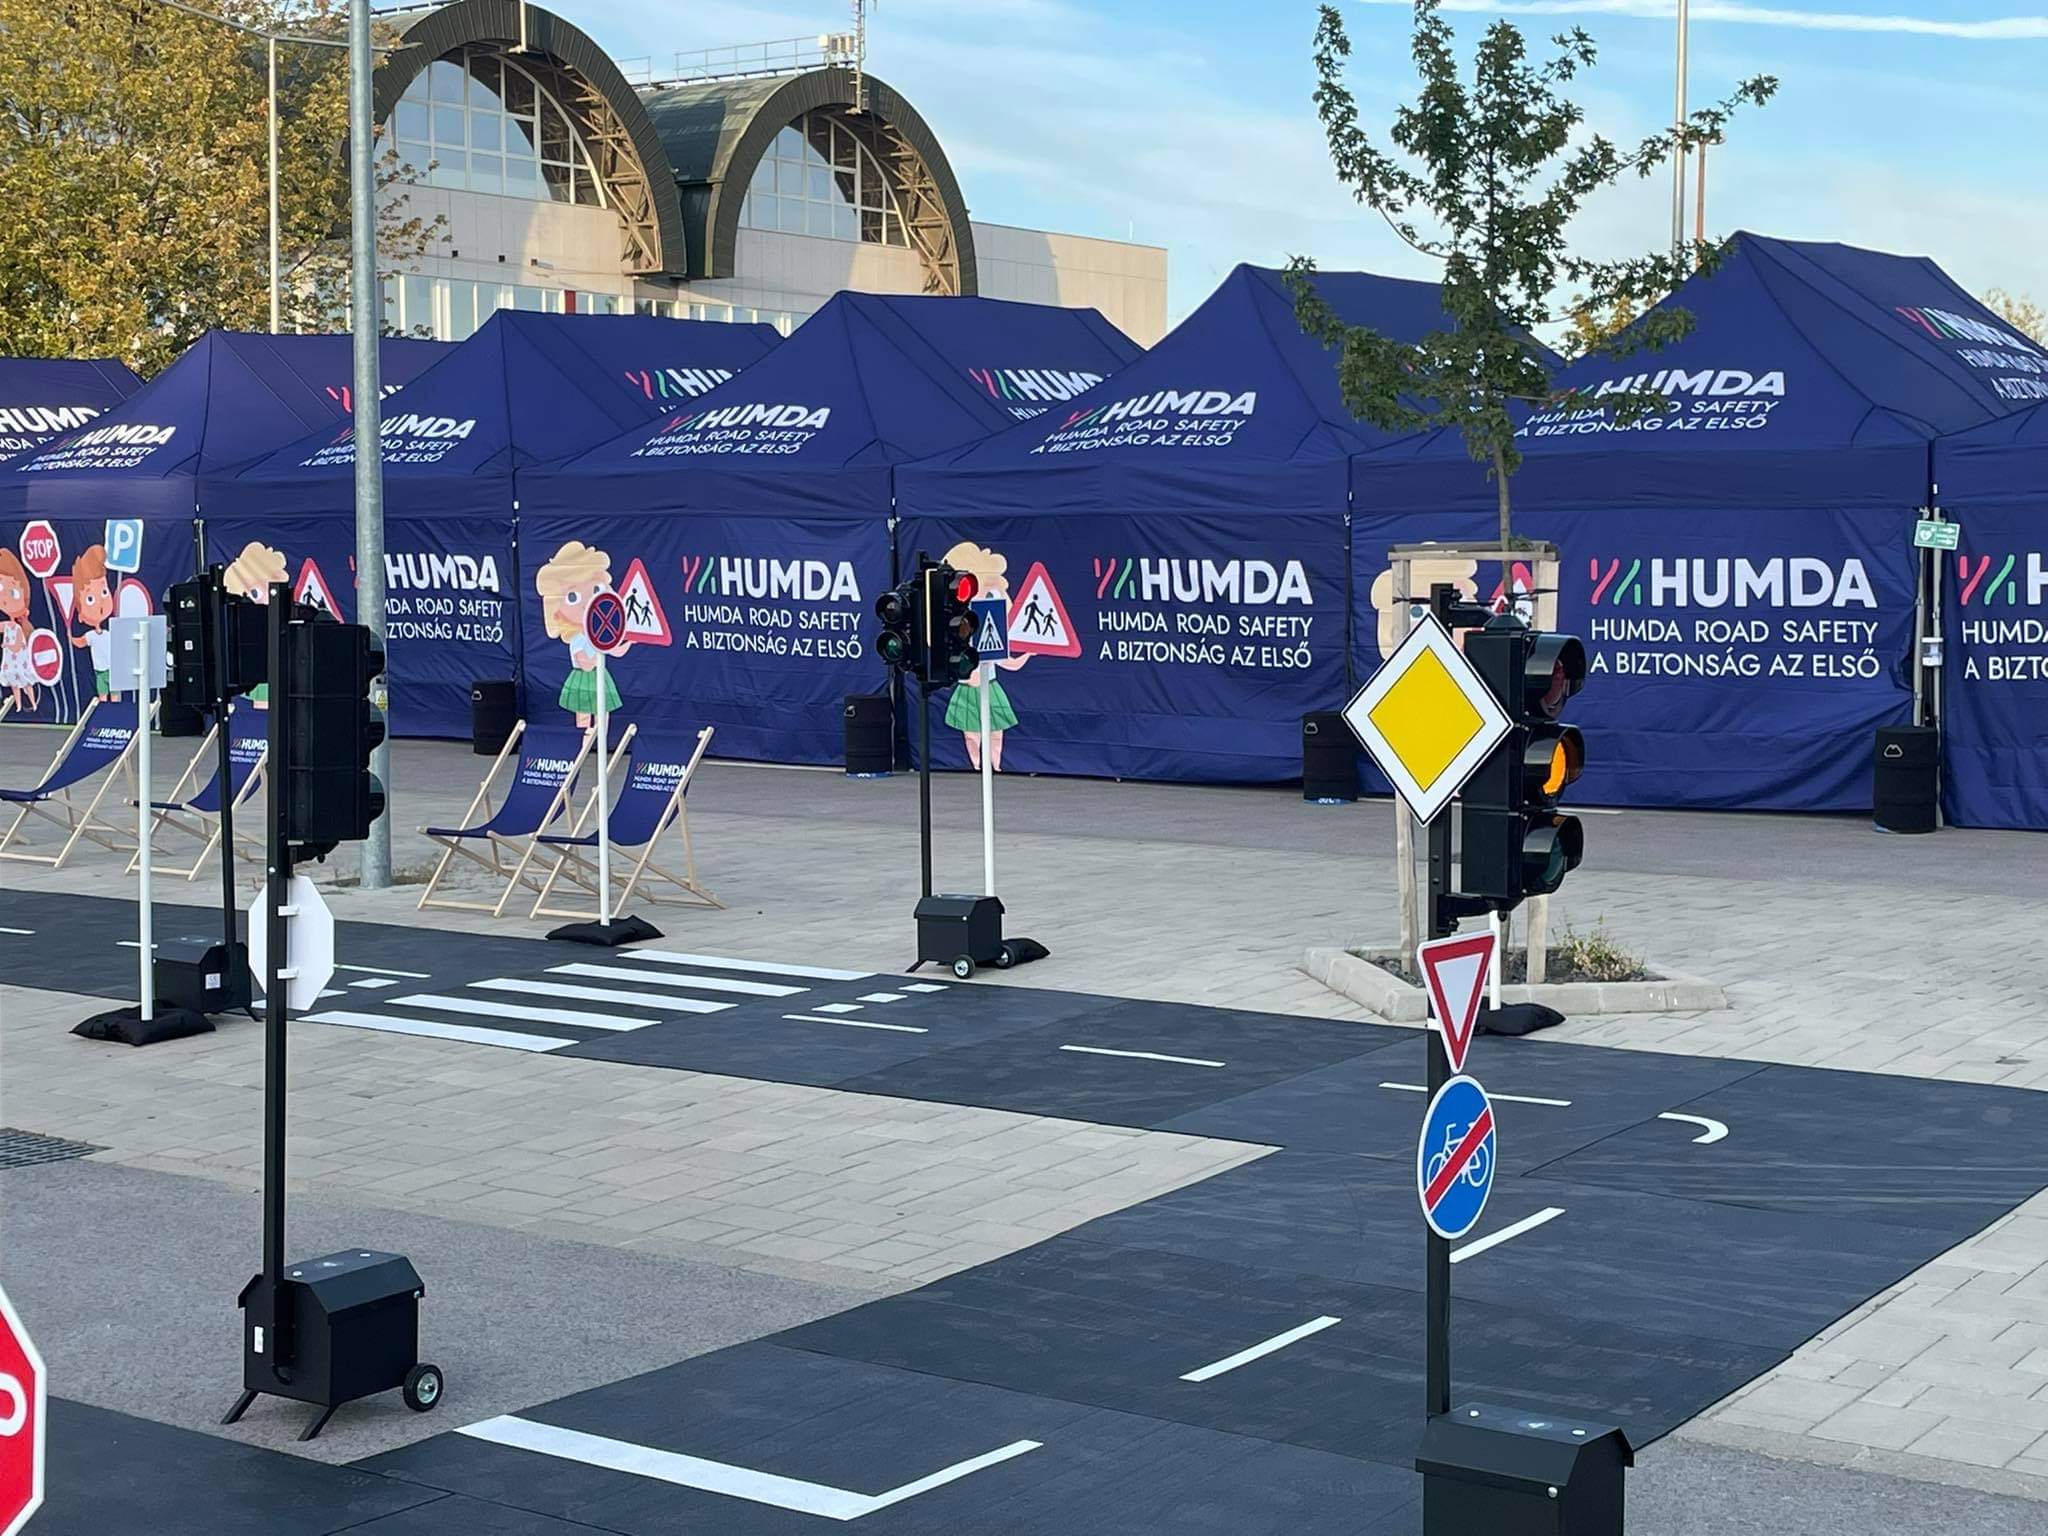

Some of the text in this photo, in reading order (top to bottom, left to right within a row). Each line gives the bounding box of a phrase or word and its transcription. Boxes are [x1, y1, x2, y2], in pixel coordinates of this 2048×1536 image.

[1004, 369, 1112, 401] HUM
[0, 406, 111, 433] HUM
[694, 404, 831, 430] HUMDA
[1099, 390, 1257, 424] HUMDA
[1694, 400, 1779, 414] SAFETY
[73, 423, 176, 448] HUMDA
[379, 413, 476, 440] UMDA
[704, 430, 752, 442] ROAD
[754, 430, 817, 442] SAFETY
[1045, 418, 1246, 444] HUMDA ROAD SAFETY
[1513, 427, 1529, 438] A
[1667, 417, 1702, 430] AZ
[1705, 413, 1769, 430] ELSŐ
[405, 440, 460, 451] SAFETY
[736, 443, 758, 455] AZ
[1029, 444, 1046, 455] A
[1154, 434, 1181, 447] AZ
[1182, 431, 1234, 447] ELSŐ
[26, 539, 54, 560] STOP
[384, 553, 500, 593] HUMDA
[720, 556, 861, 603] HUMDA
[1140, 558, 1314, 605] HUMDA
[1652, 558, 1878, 608] HUMDA
[416, 598, 454, 615] ROAD
[459, 599, 503, 618] SAFETY
[685, 605, 861, 631] HUMDA ROAD SAFETY
[386, 617, 504, 643] ZTONSÁG AZ ELSŐ
[1099, 611, 1313, 637] HUMDA ROAD SAFETY
[1591, 618, 1878, 644] HUMDA ROAD SAFETY
[686, 629, 863, 659] A BIZTONSÁG AZ ELSŐ
[1099, 638, 1313, 668] A BIZTONSÁG AZ ELSŐ
[1590, 647, 1880, 678] A BIZTONSÁG AZ ELSŐ
[1964, 656, 1981, 680] A
[646, 762, 686, 777] HUMDA
